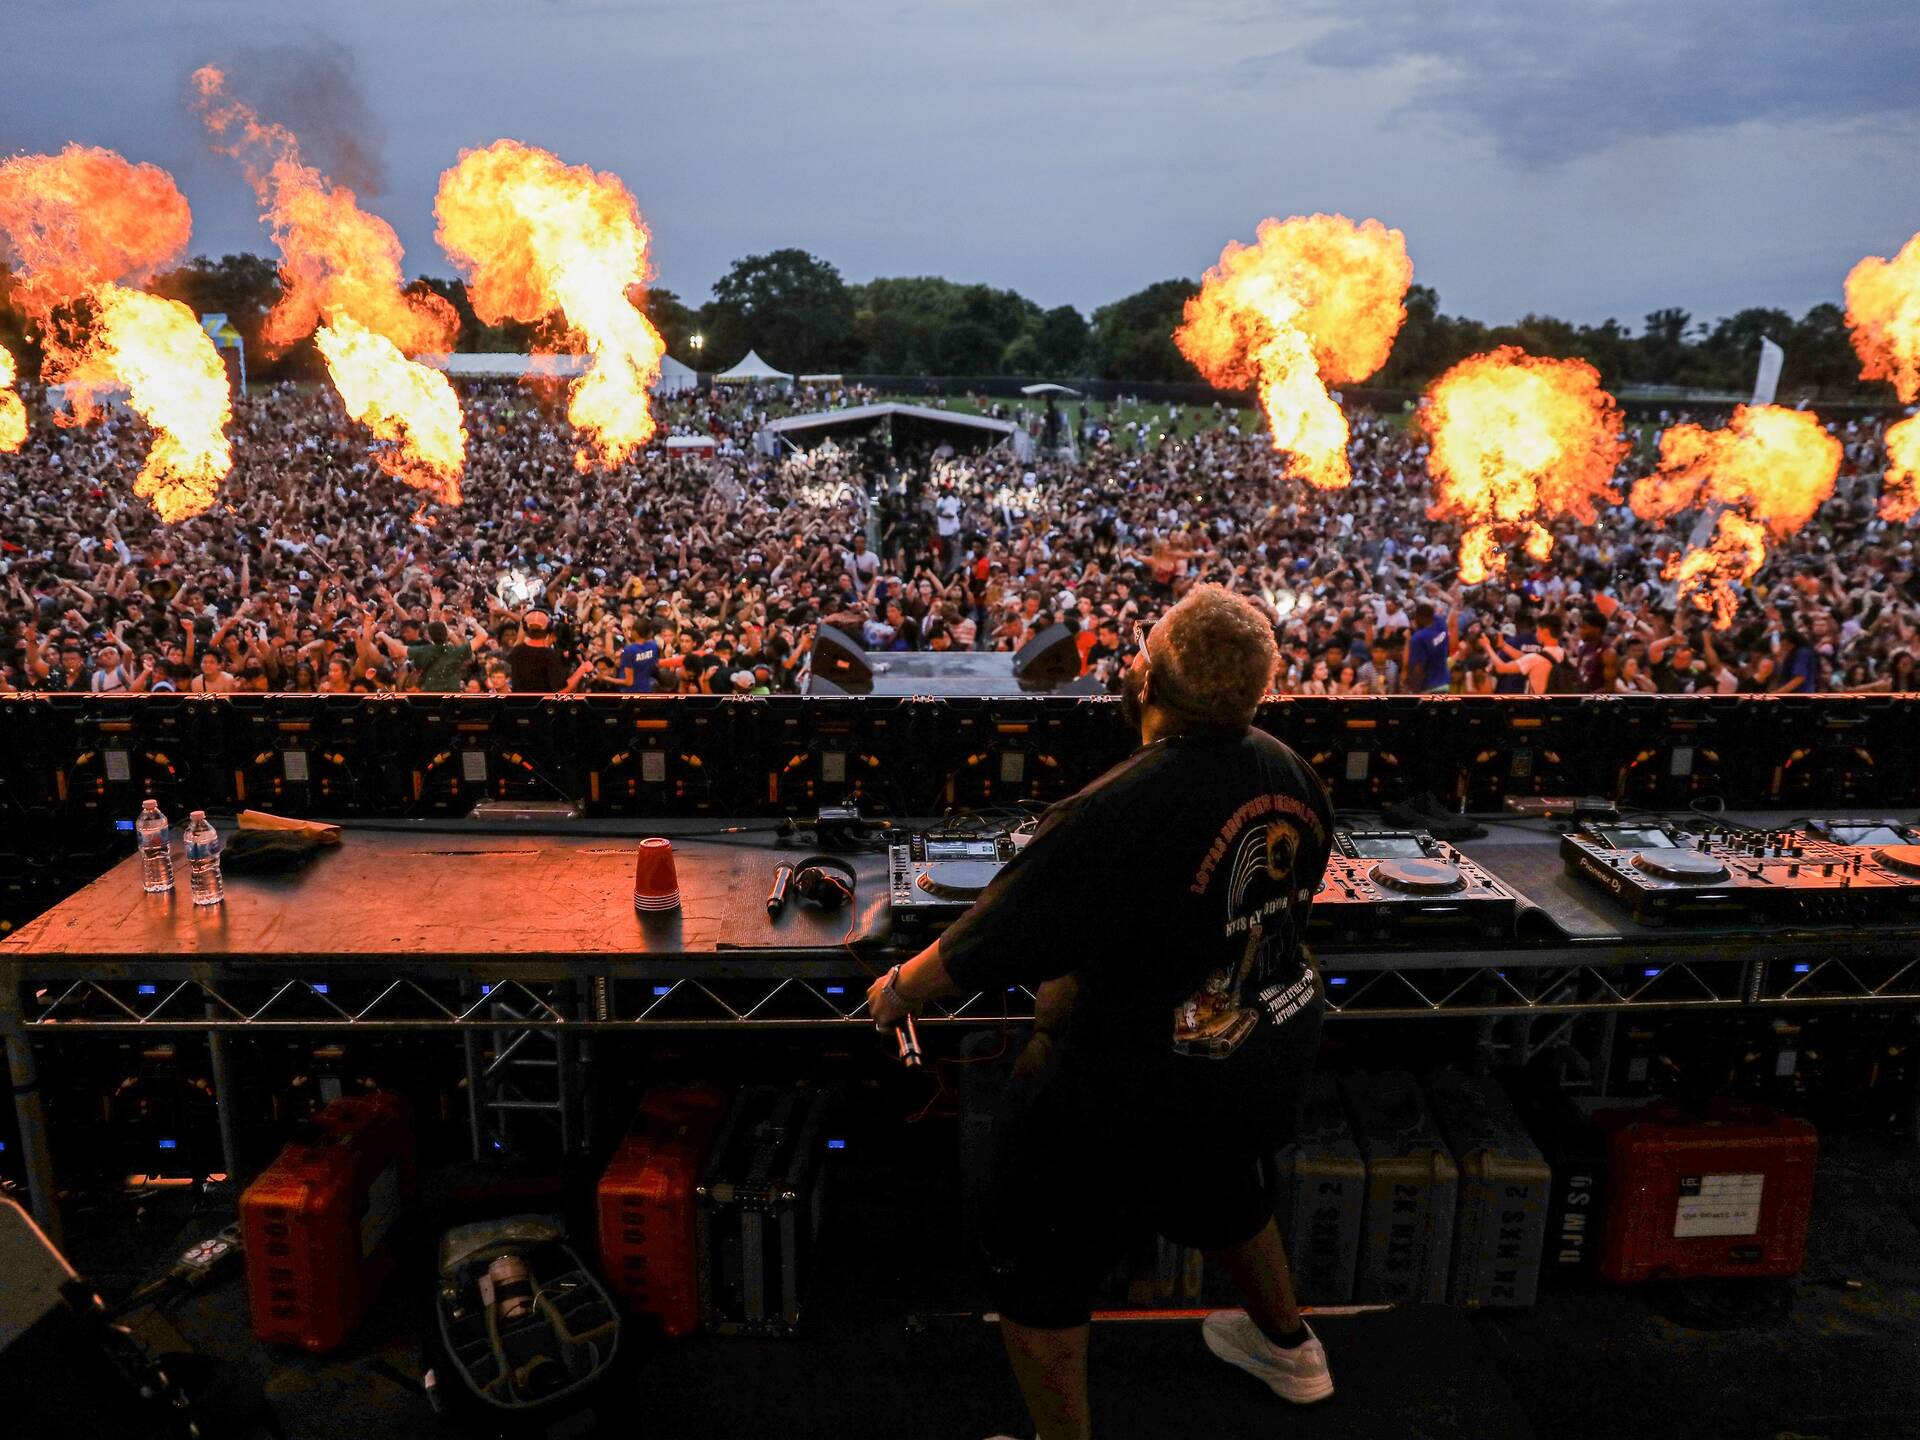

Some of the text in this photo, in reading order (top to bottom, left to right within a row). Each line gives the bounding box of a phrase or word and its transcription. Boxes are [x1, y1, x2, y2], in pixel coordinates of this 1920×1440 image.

[1579, 856, 1623, 894] Pioneer DJ
[1491, 1185, 1529, 1299] 2K NXS 2
[1560, 1213, 1587, 1263] DJM
